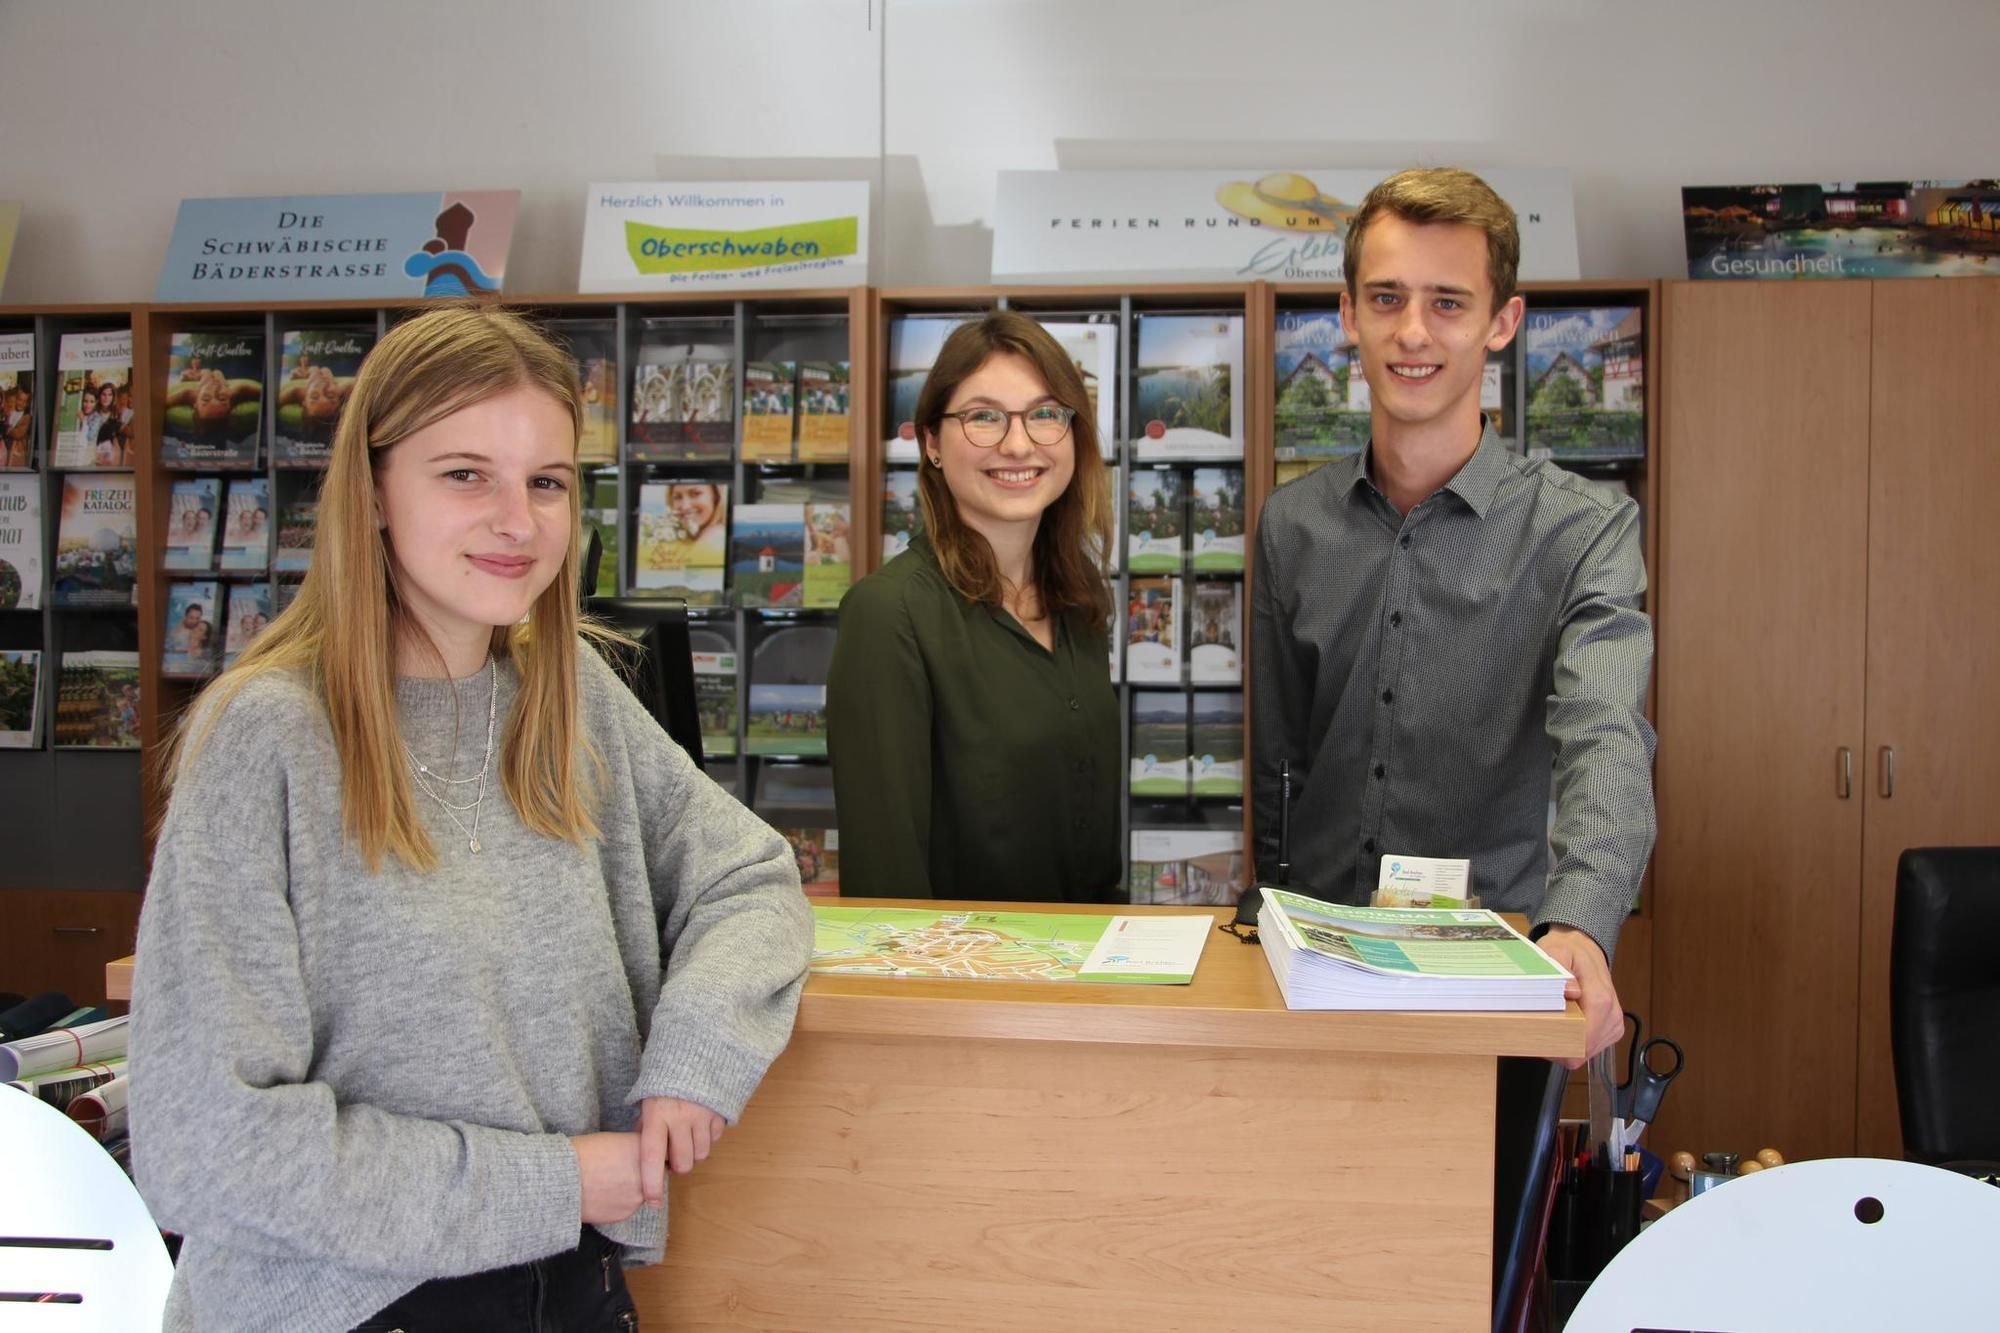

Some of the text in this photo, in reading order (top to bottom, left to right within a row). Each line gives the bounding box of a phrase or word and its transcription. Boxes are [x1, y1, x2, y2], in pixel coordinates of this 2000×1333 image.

[600, 194, 785, 209] Herzlich Willkommen in
[1051, 216, 1320, 229] FERIEN RUND UM
[640, 237, 820, 258] Oberschwaben
[1711, 253, 1845, 275] Gesundheit
[740, 269, 761, 279] und
[82, 344, 131, 358] verzaube
[83, 501, 132, 511] KATALOG
